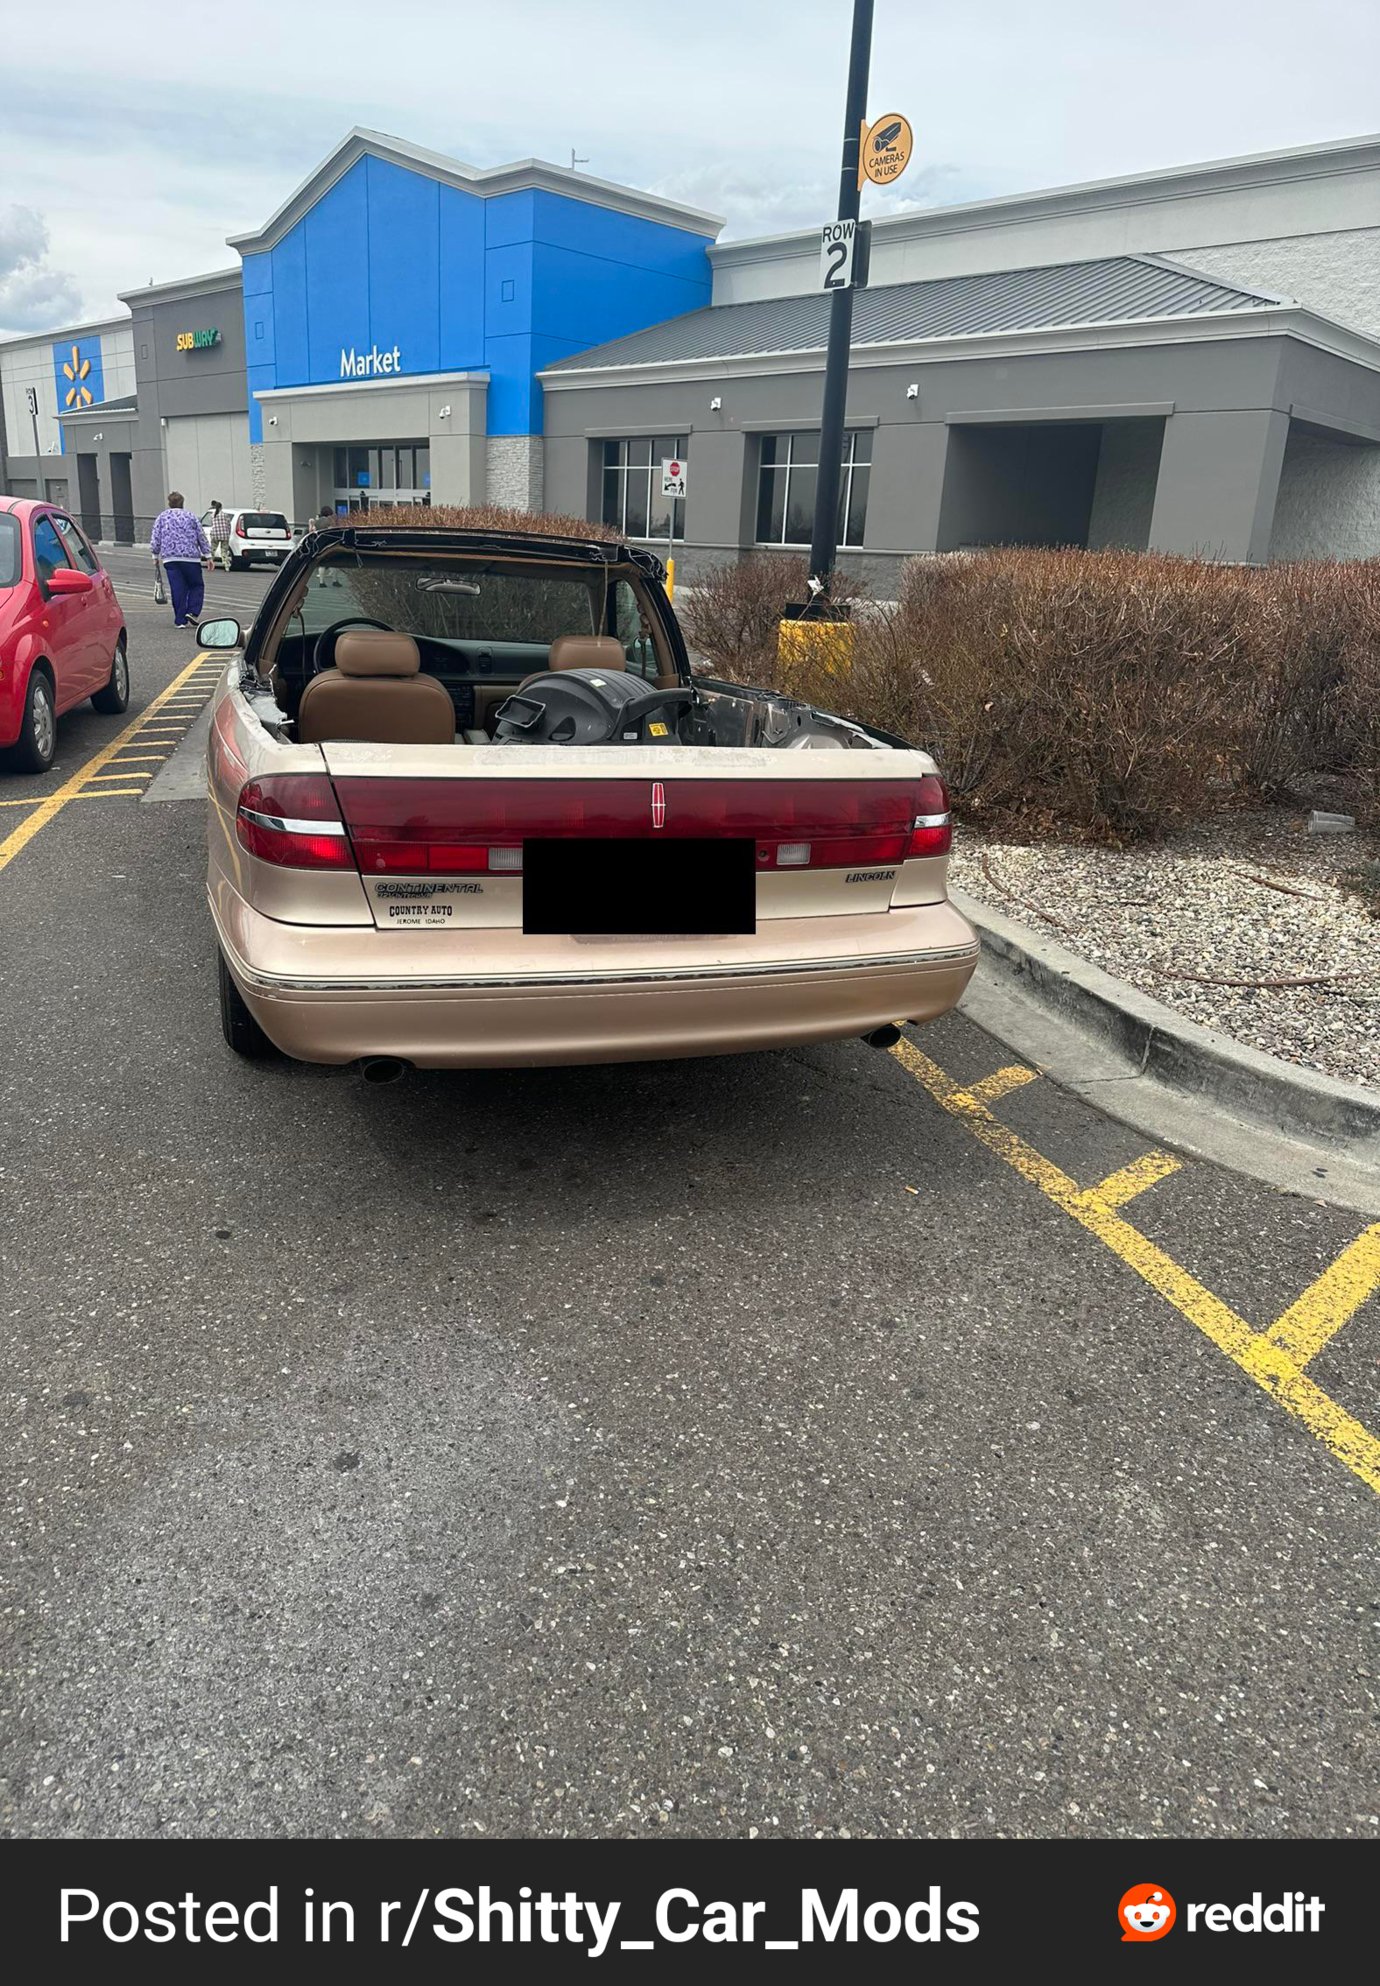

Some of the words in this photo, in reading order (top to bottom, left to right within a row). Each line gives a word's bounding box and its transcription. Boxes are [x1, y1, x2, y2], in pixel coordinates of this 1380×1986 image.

[869, 151, 904, 168] CAMERAS
[875, 167, 883, 177] IN
[884, 164, 898, 175] USE
[823, 222, 855, 243] ROW
[824, 241, 848, 289] 2
[176, 327, 218, 351] SUBWAY
[340, 345, 401, 377] Market
[28, 395, 35, 414] 3
[845, 870, 896, 883] LINCOLN
[375, 882, 484, 893] CONTINENTAL
[390, 905, 429, 917] COUNTRY
[431, 905, 452, 916] AUTO
